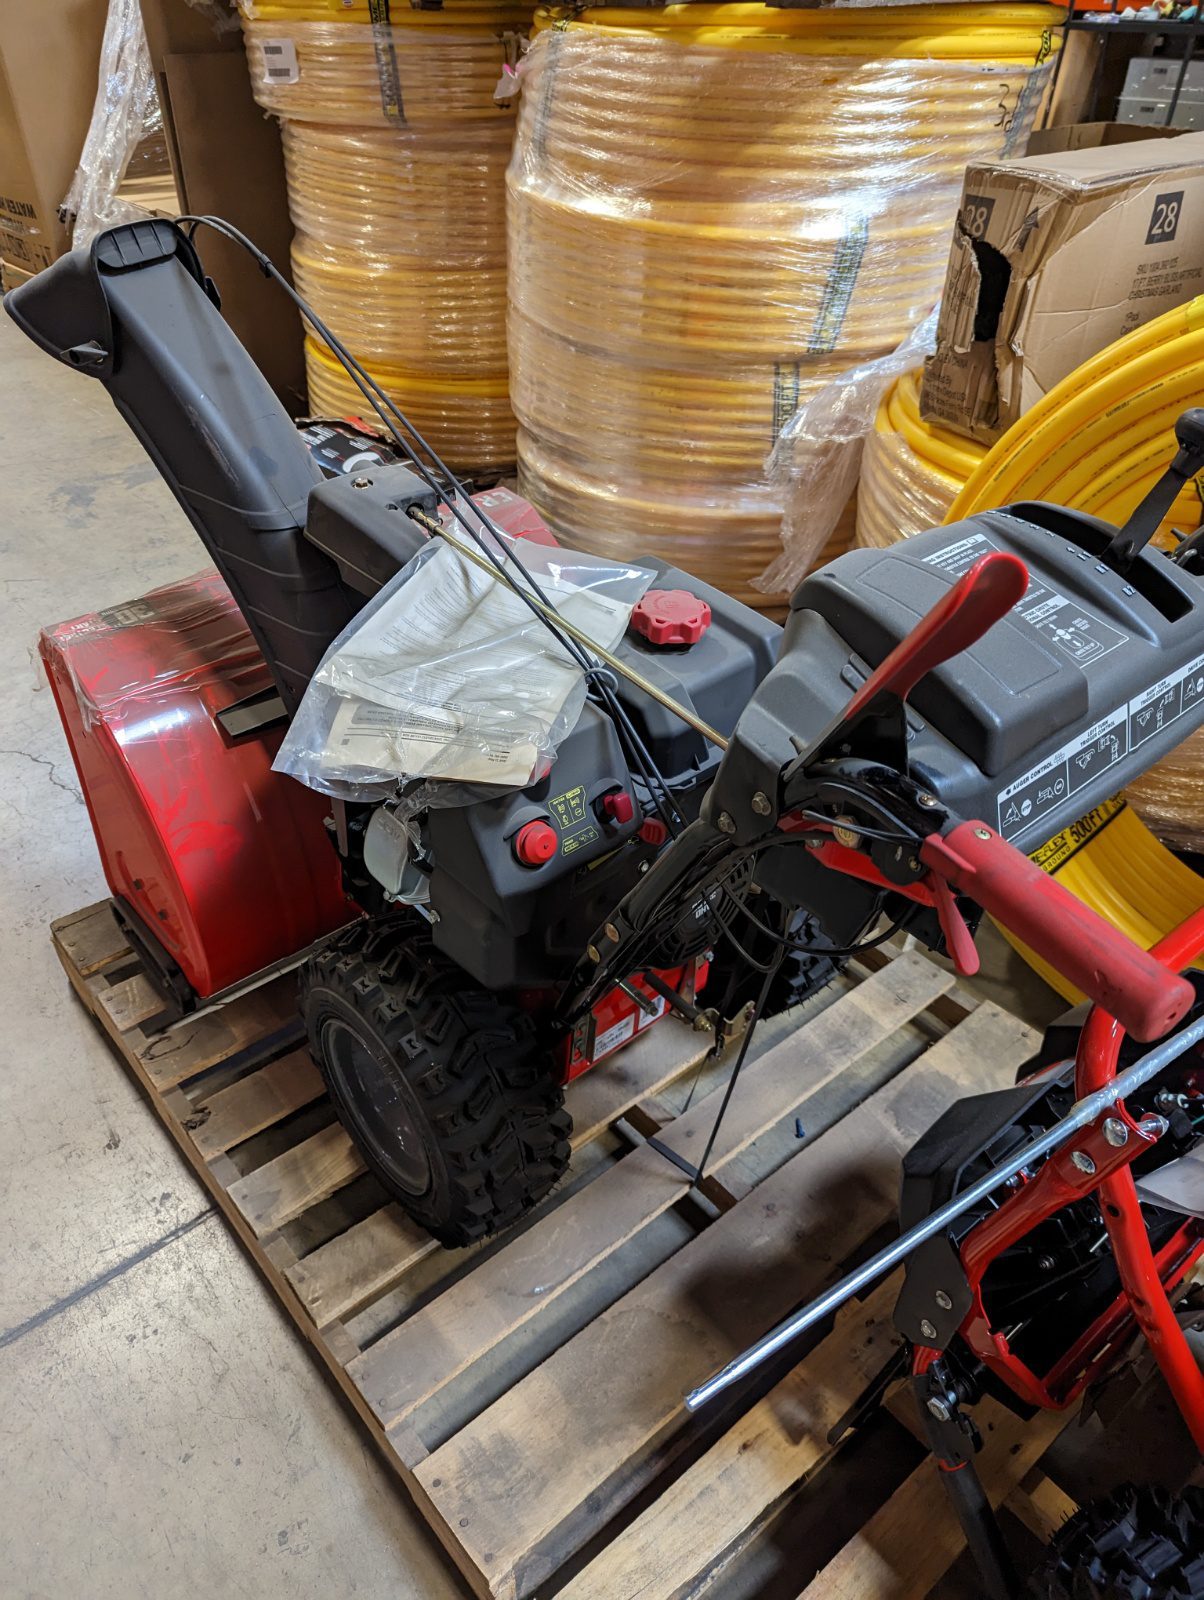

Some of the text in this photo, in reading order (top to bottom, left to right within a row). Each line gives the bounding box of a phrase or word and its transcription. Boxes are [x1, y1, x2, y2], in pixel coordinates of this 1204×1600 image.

[1151, 201, 1176, 236] 28
[1012, 761, 1053, 791] AUGER CONTROL
[1069, 808, 1105, 844] 500FT
[1043, 845, 1071, 872] GROUND
